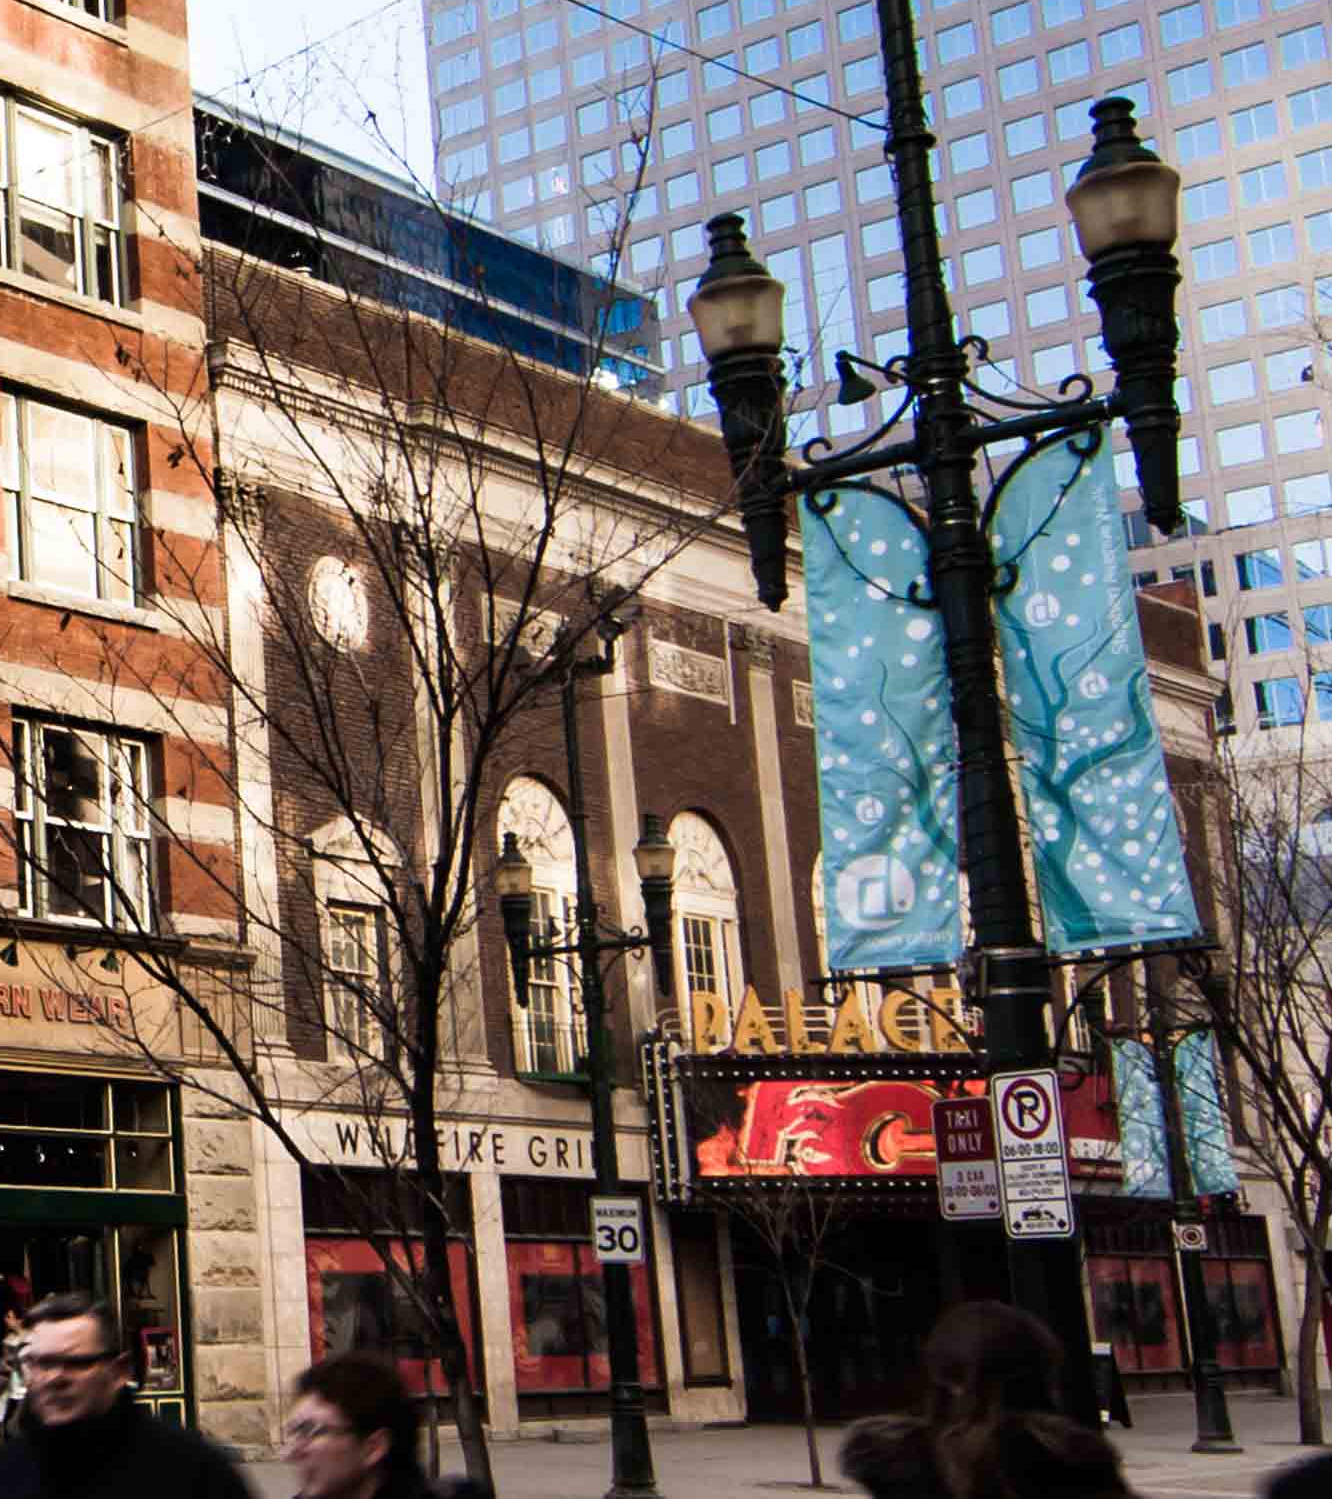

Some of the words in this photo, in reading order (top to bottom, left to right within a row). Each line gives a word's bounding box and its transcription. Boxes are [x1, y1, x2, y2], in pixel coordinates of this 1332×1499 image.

[39, 987, 131, 1030] WEAR
[690, 983, 972, 1054] PALACE
[944, 1109, 979, 1129] TAXI
[528, 1134, 596, 1170] GRI
[946, 1133, 983, 1153] ONLY
[596, 1224, 640, 1254] 30
